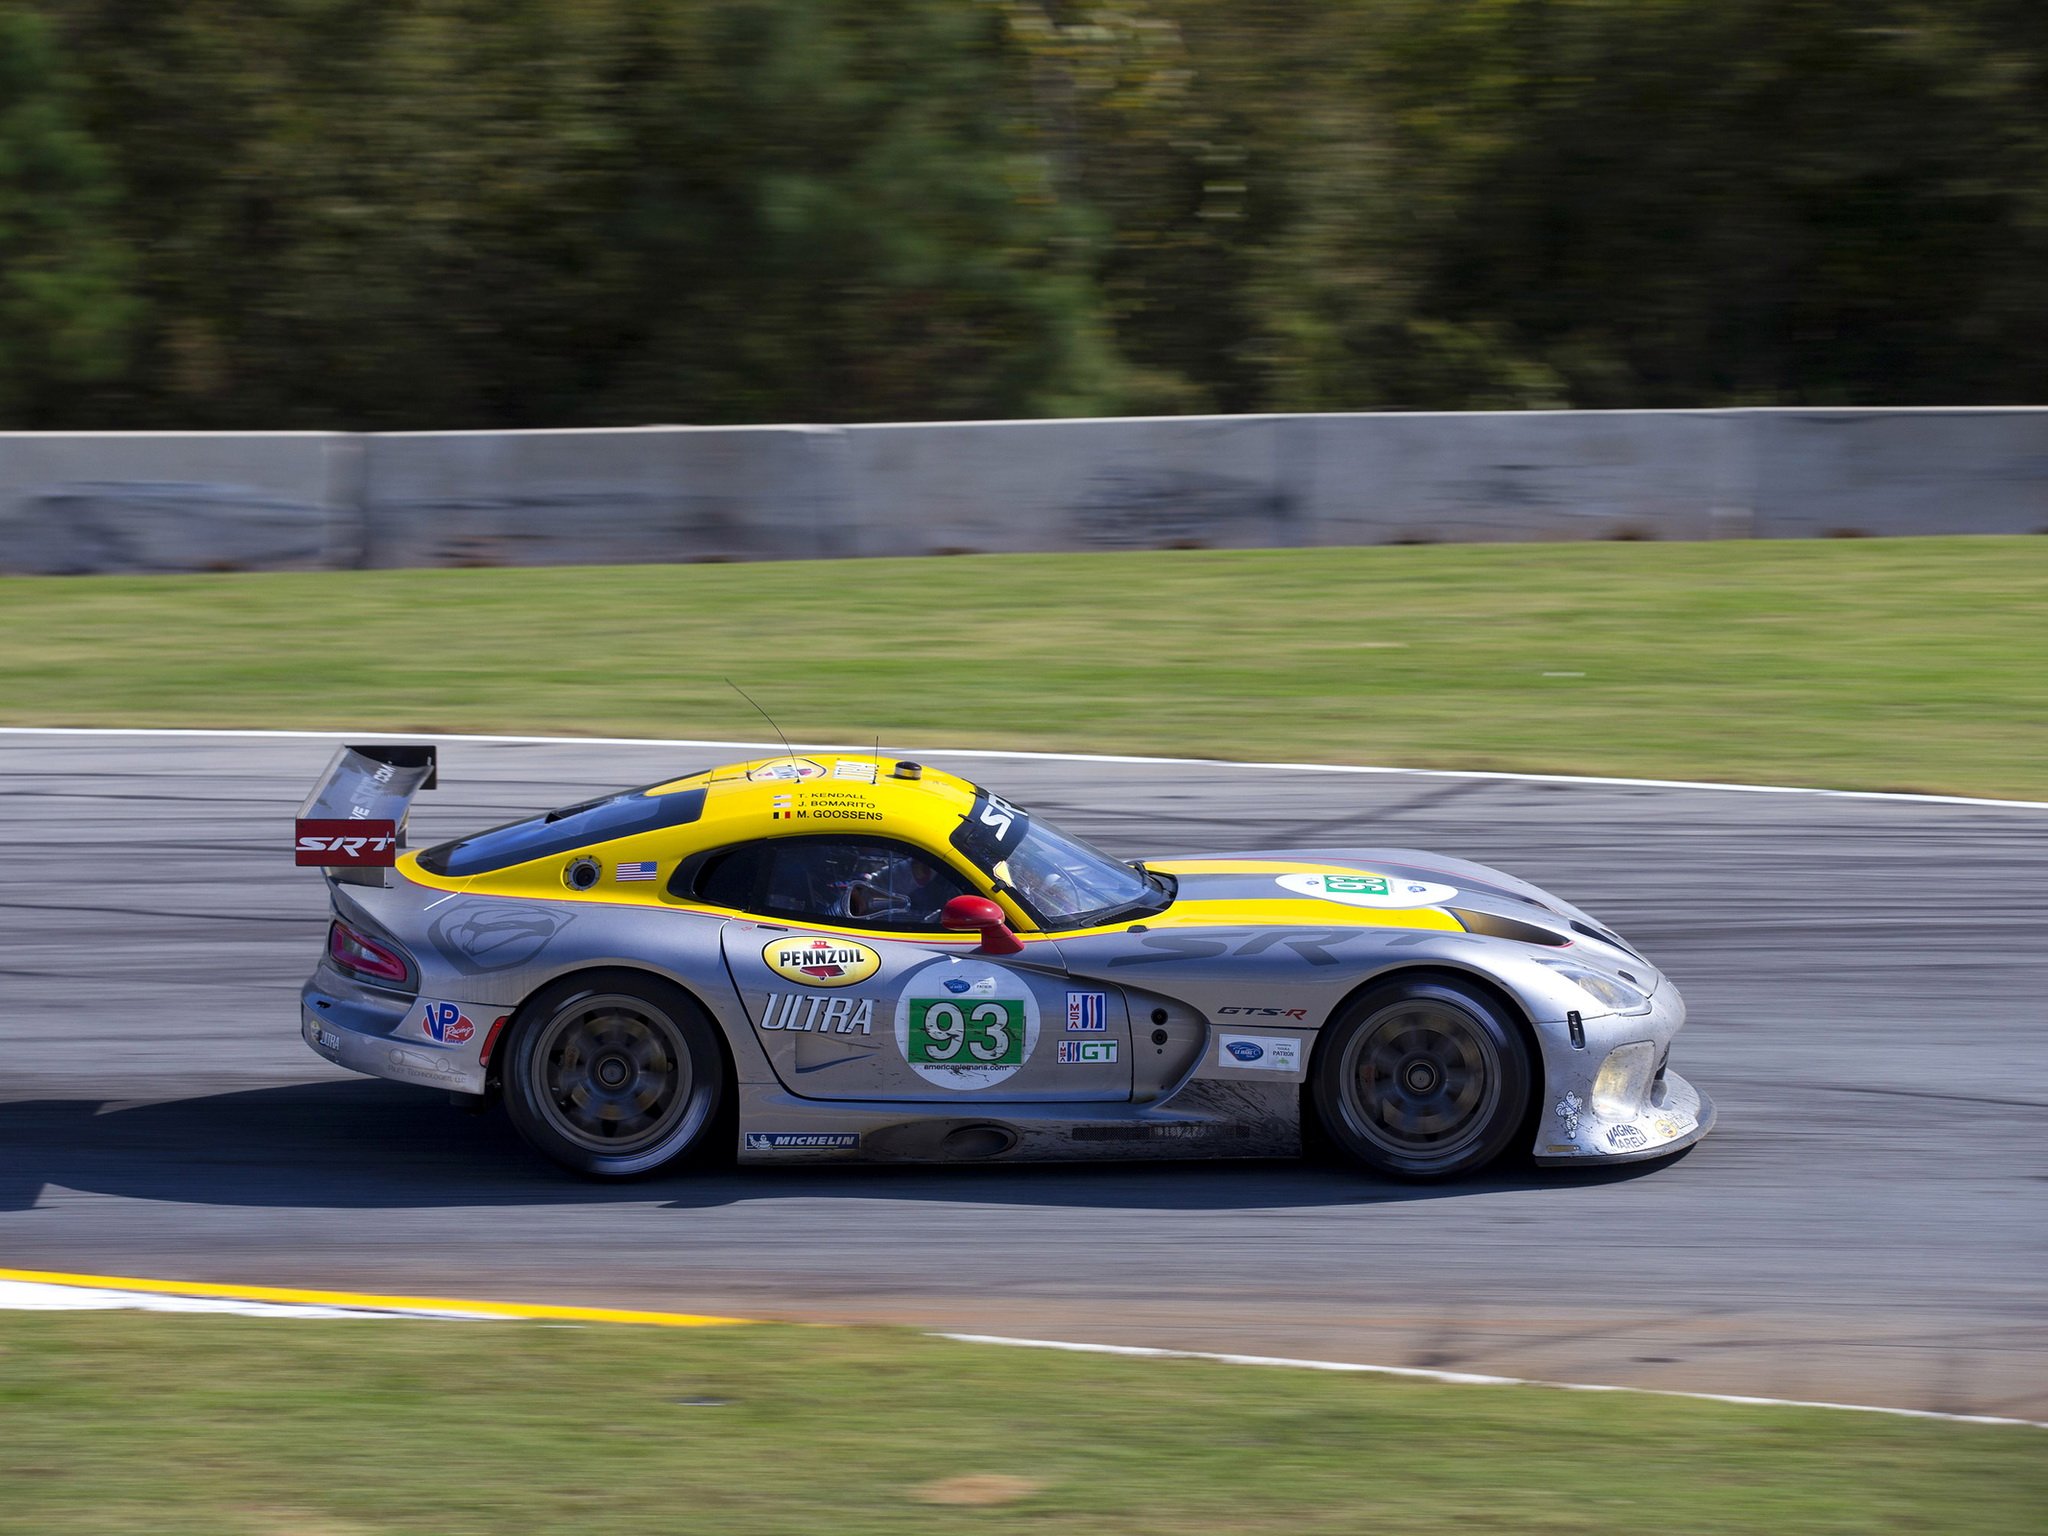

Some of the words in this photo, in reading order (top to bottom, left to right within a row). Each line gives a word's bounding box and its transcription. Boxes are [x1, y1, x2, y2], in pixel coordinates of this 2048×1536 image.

[811, 801, 875, 809] BOMARITO
[797, 810, 809, 818] M.
[813, 810, 883, 820] GOOSSENS
[296, 836, 395, 857] SRT
[1107, 930, 1487, 966] SRT
[779, 949, 865, 967] PENNZOIL
[760, 992, 875, 1035] ULTRA
[1070, 994, 1079, 1029] IMSA
[1217, 1006, 1308, 1020] GTS-R
[425, 1002, 459, 1042] VP
[924, 1001, 1010, 1061] 93
[446, 1026, 474, 1038] Racing
[1082, 1043, 1116, 1060] GT
[775, 1136, 855, 1145] MICHELIN
